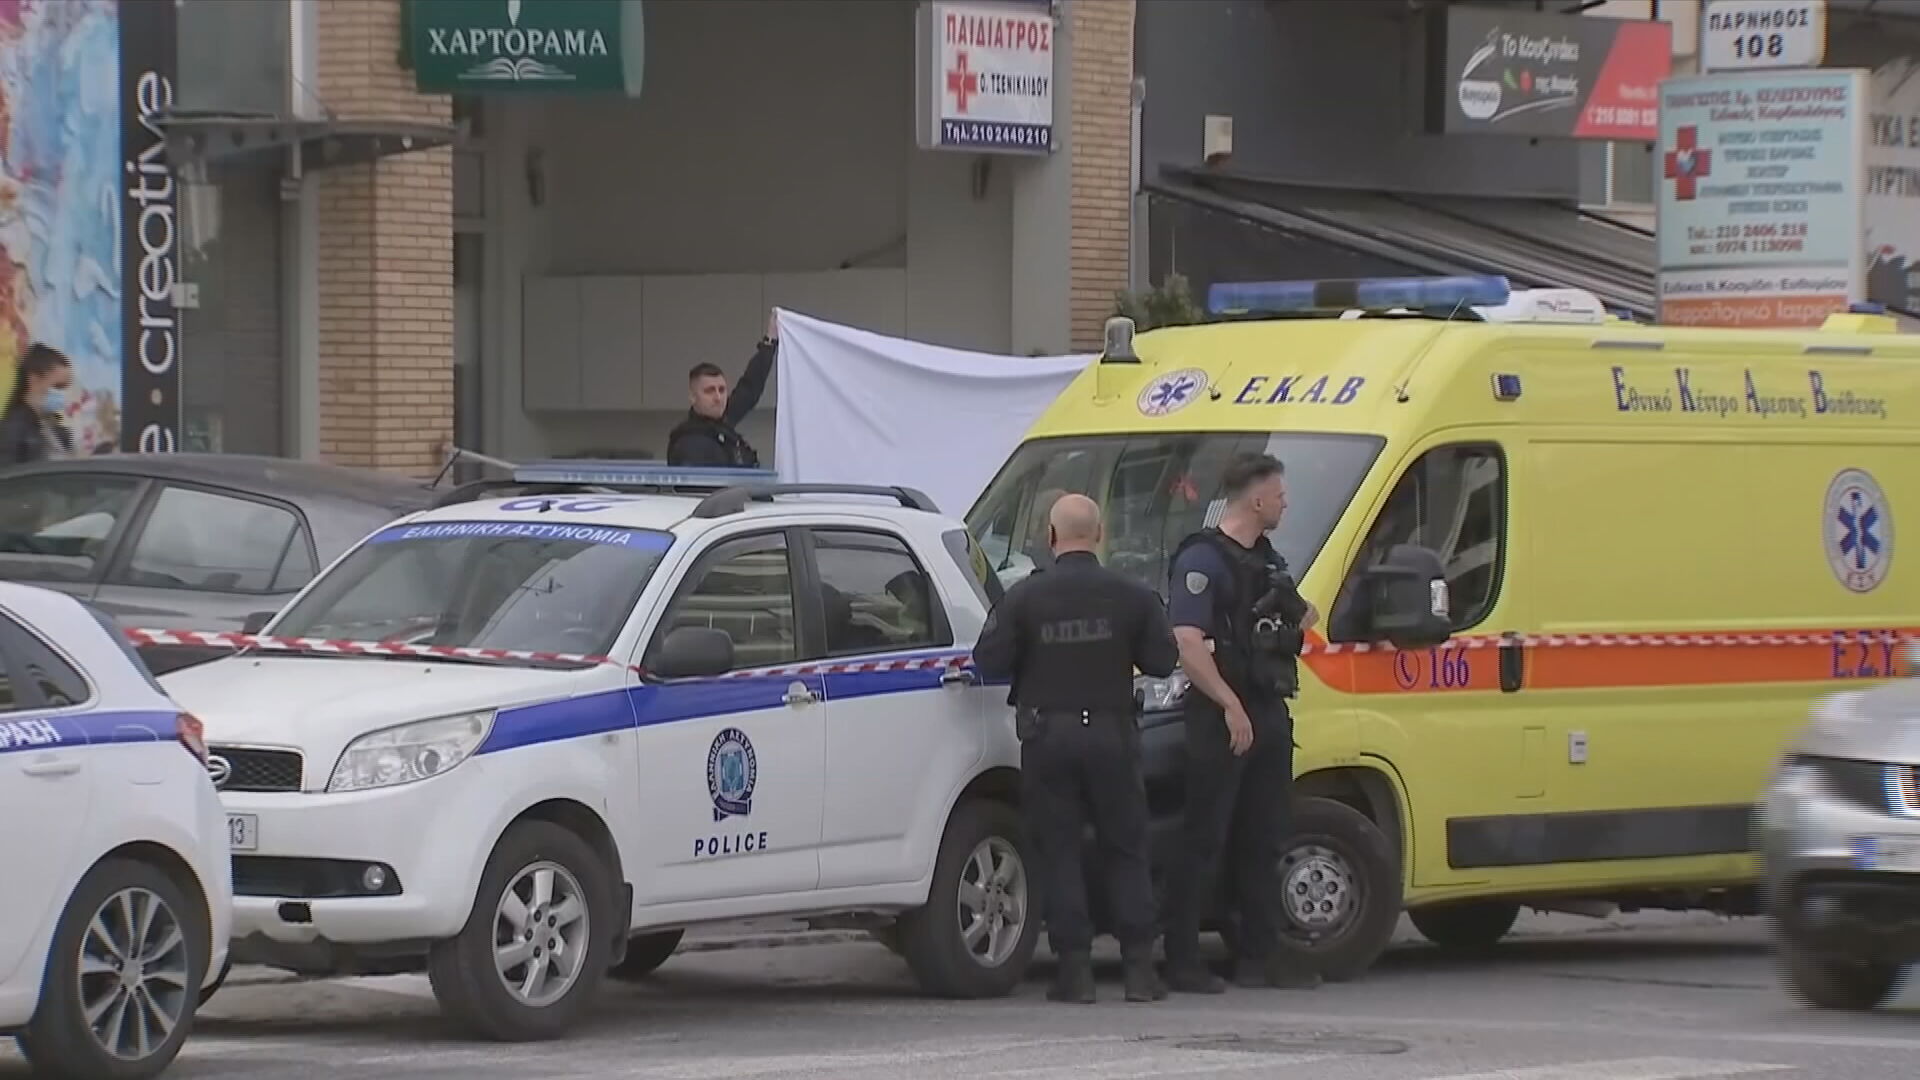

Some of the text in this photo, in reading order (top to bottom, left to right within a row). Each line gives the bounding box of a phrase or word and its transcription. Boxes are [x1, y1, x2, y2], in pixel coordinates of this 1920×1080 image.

[946, 14, 1049, 51] ΠΑΙΔΙΑΤΡΟΣ
[1709, 8, 1809, 31] ΠΑΡΝΗΘΟΣ
[428, 28, 608, 56] ΧΑΡΤΟΡΑΜΑ
[1733, 34, 1783, 58] 108
[127, 70, 174, 375] creative
[1612, 366, 1672, 412] Εθνικό
[1676, 367, 1738, 418] Κέντρο
[401, 524, 632, 546] ΕΛΛΗΝΙΚΗ ΑΣΤΥΝΟΜΙΑ
[1429, 647, 1470, 688] 166
[0, 719, 63, 748] ΡΑΣΗ
[694, 831, 768, 858] POLICE
